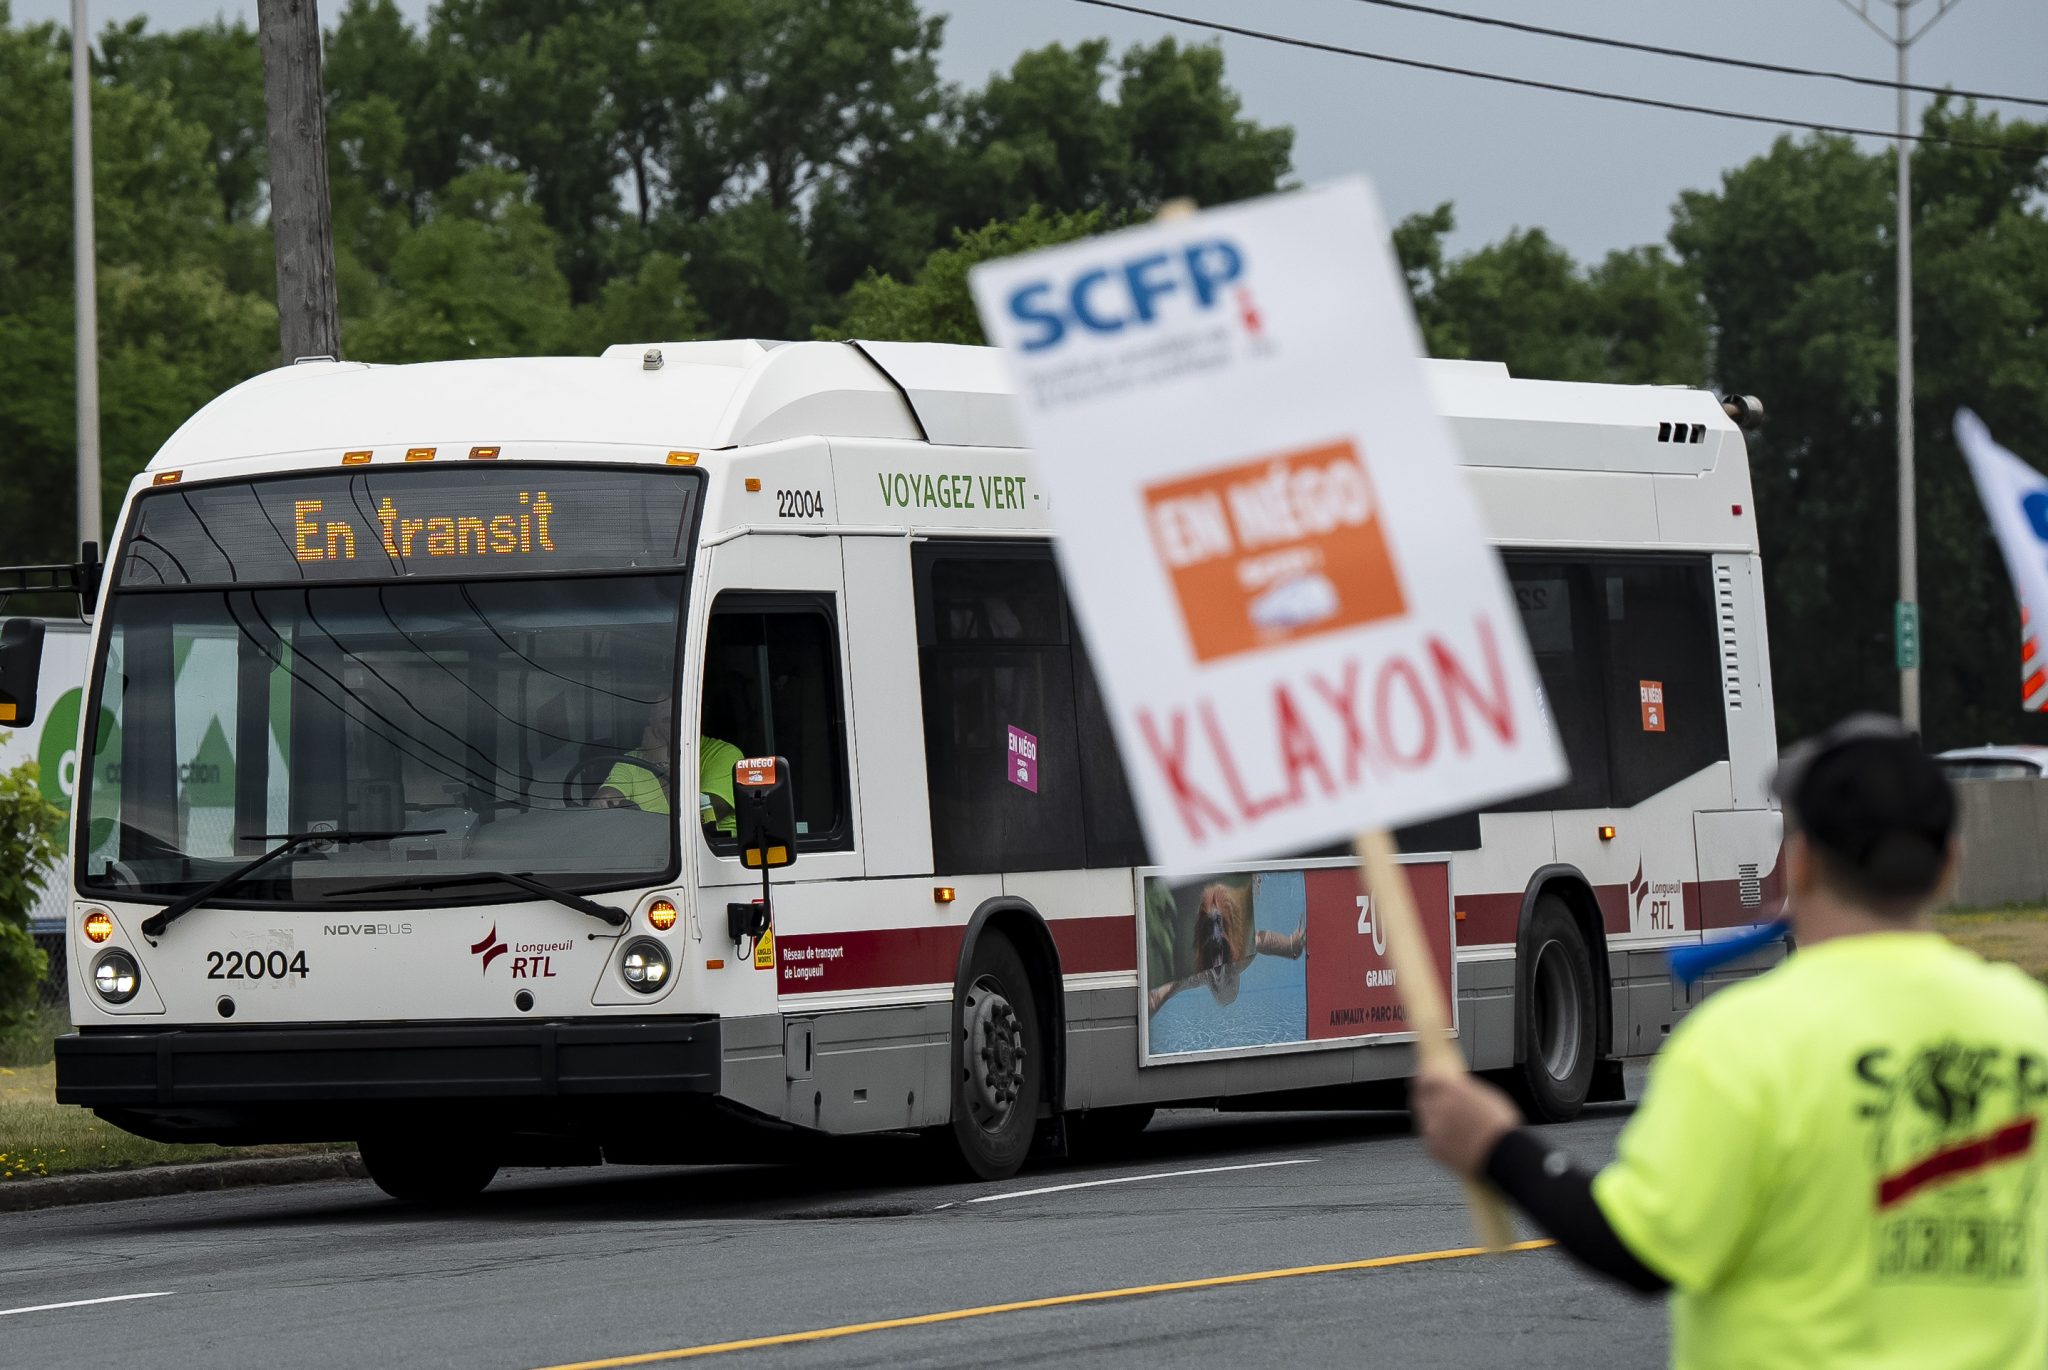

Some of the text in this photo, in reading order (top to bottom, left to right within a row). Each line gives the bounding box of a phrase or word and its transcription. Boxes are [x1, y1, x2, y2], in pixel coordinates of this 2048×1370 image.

[1007, 238, 1244, 351] SCFP
[776, 489, 824, 518] 22004
[878, 472, 975, 509] VOYAGEZ
[979, 475, 1026, 510] VERT
[295, 491, 556, 560] En transit
[1156, 460, 1371, 566] EN NÉGO
[1136, 612, 1518, 844] KLAXON
[1008, 732, 1036, 761] EN NÉGO
[737, 757, 773, 769] EN NÉGO
[1652, 879, 1681, 897] Longueuil
[1650, 901, 1674, 930] RTL
[515, 939, 573, 954] Longueuil
[783, 946, 844, 961] Réseau de transport
[206, 950, 310, 979] 22004
[510, 956, 557, 979] RTL
[784, 964, 824, 981] de Longueuil
[1365, 969, 1398, 988] GRANBY
[1330, 1008, 1365, 1026] ANIMAUX
[1370, 1006, 1392, 1023] PARC
